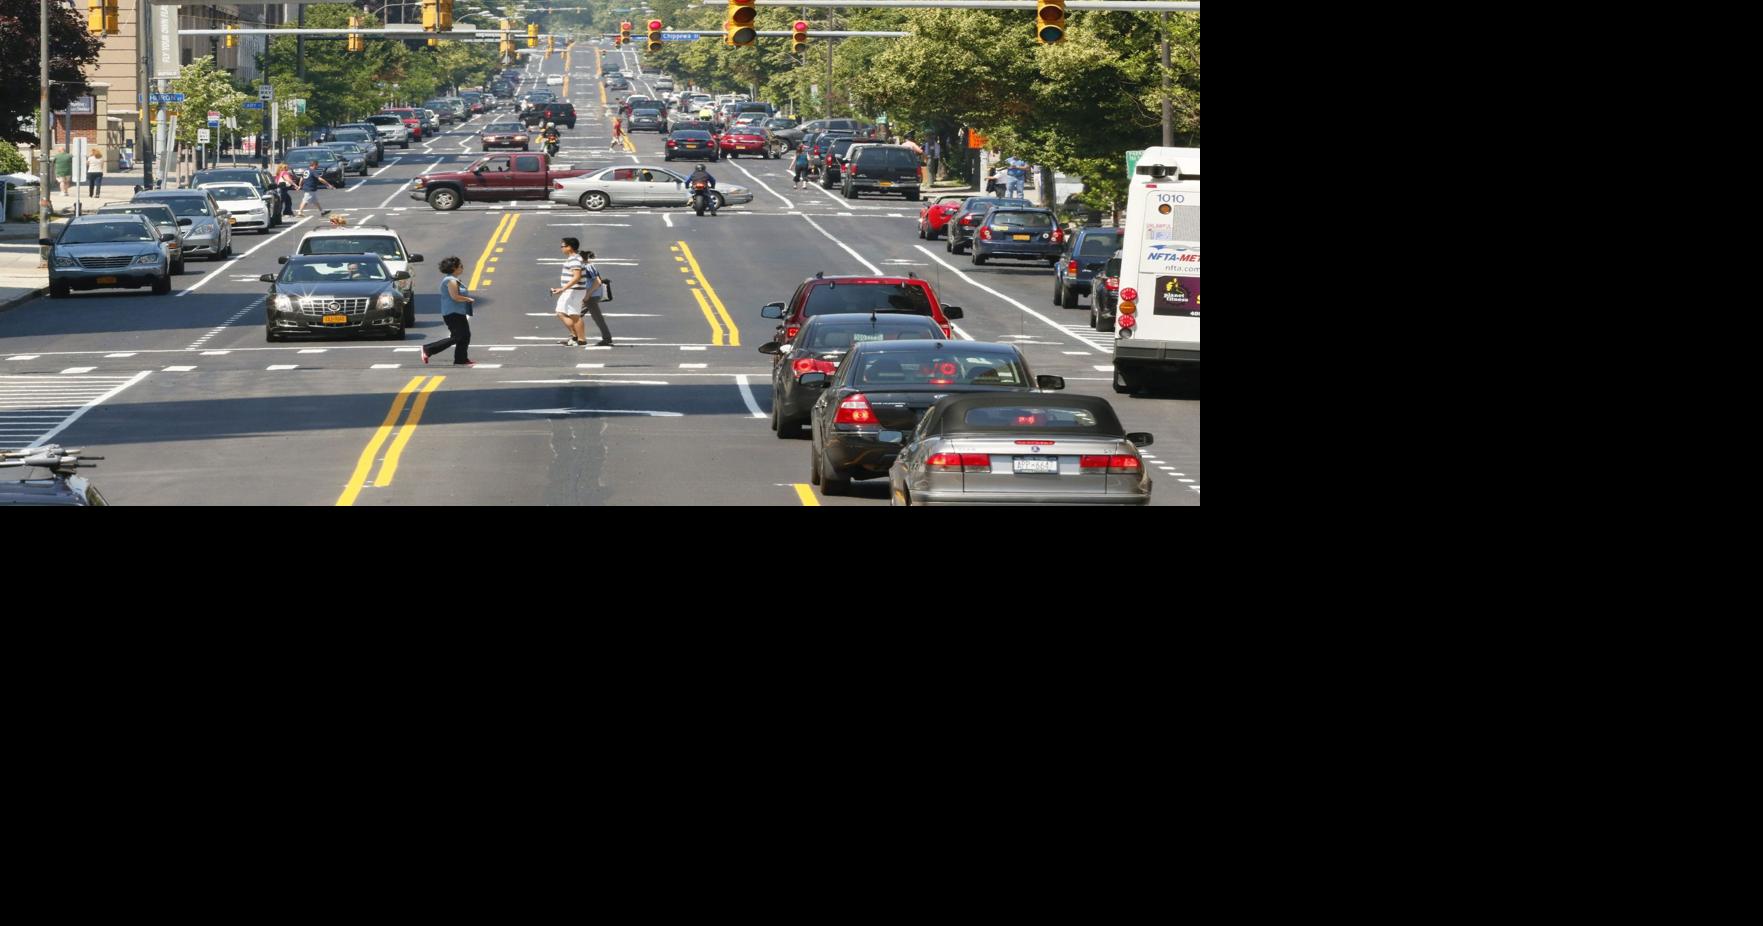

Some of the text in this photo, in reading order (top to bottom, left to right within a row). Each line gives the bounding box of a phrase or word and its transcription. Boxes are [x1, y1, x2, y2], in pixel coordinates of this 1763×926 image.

[160, 19, 169, 34] OWN
[161, 35, 170, 51] YOUR
[161, 52, 170, 63] FLY
[1157, 193, 1185, 203] 1010
